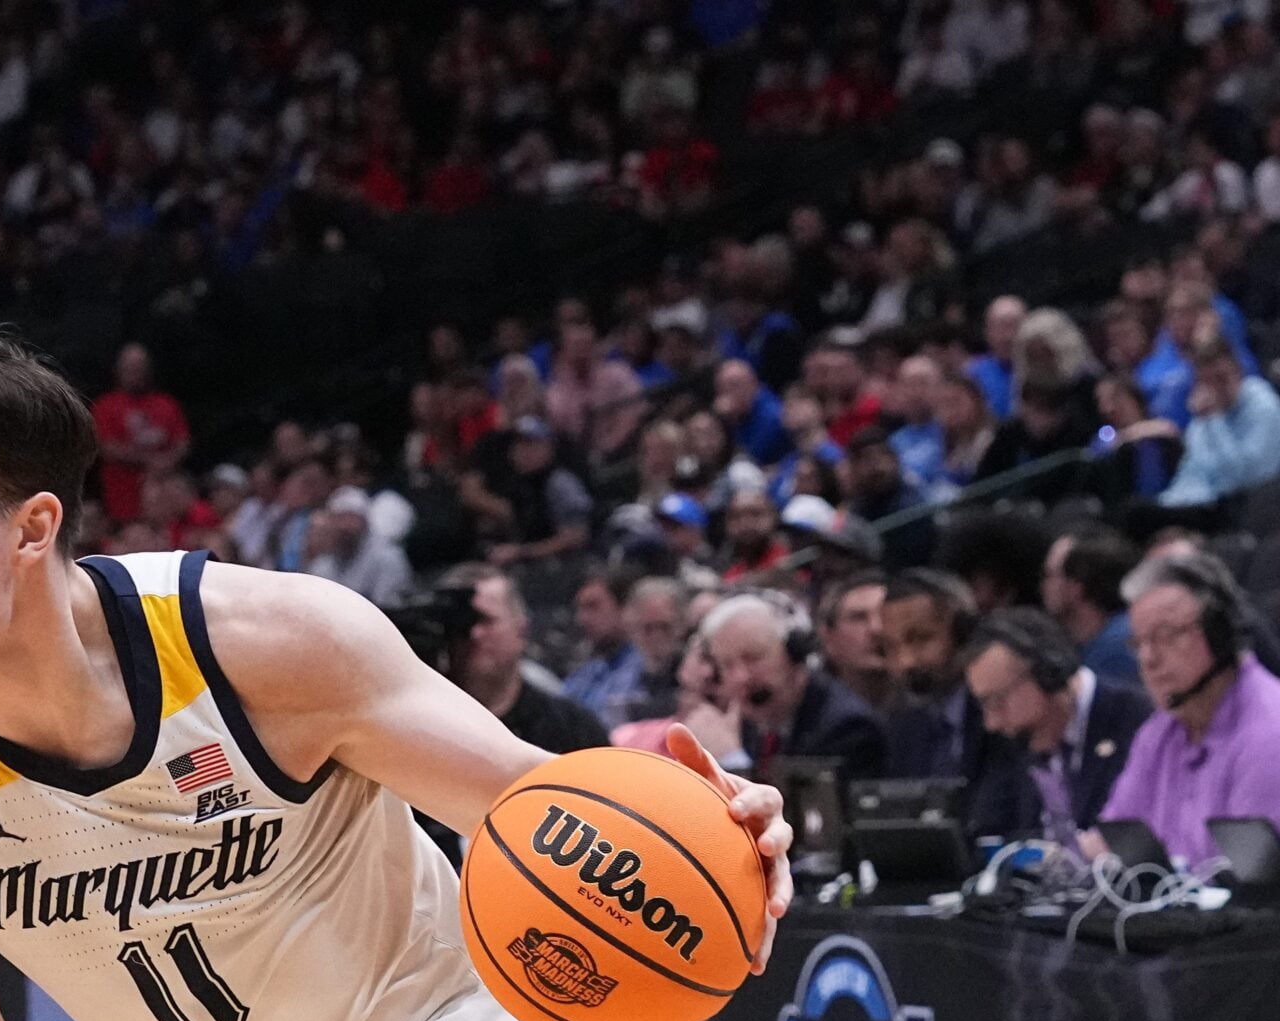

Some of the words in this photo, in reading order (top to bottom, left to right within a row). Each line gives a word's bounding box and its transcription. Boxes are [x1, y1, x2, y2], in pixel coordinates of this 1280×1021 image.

[196, 789, 252, 820] EAST
[197, 783, 234, 804] BIG
[531, 802, 705, 966] Wilson
[577, 886, 604, 907] EVO
[606, 905, 632, 927] NXT
[534, 957, 606, 1005] MADNESS
[536, 941, 589, 982] MARCH
